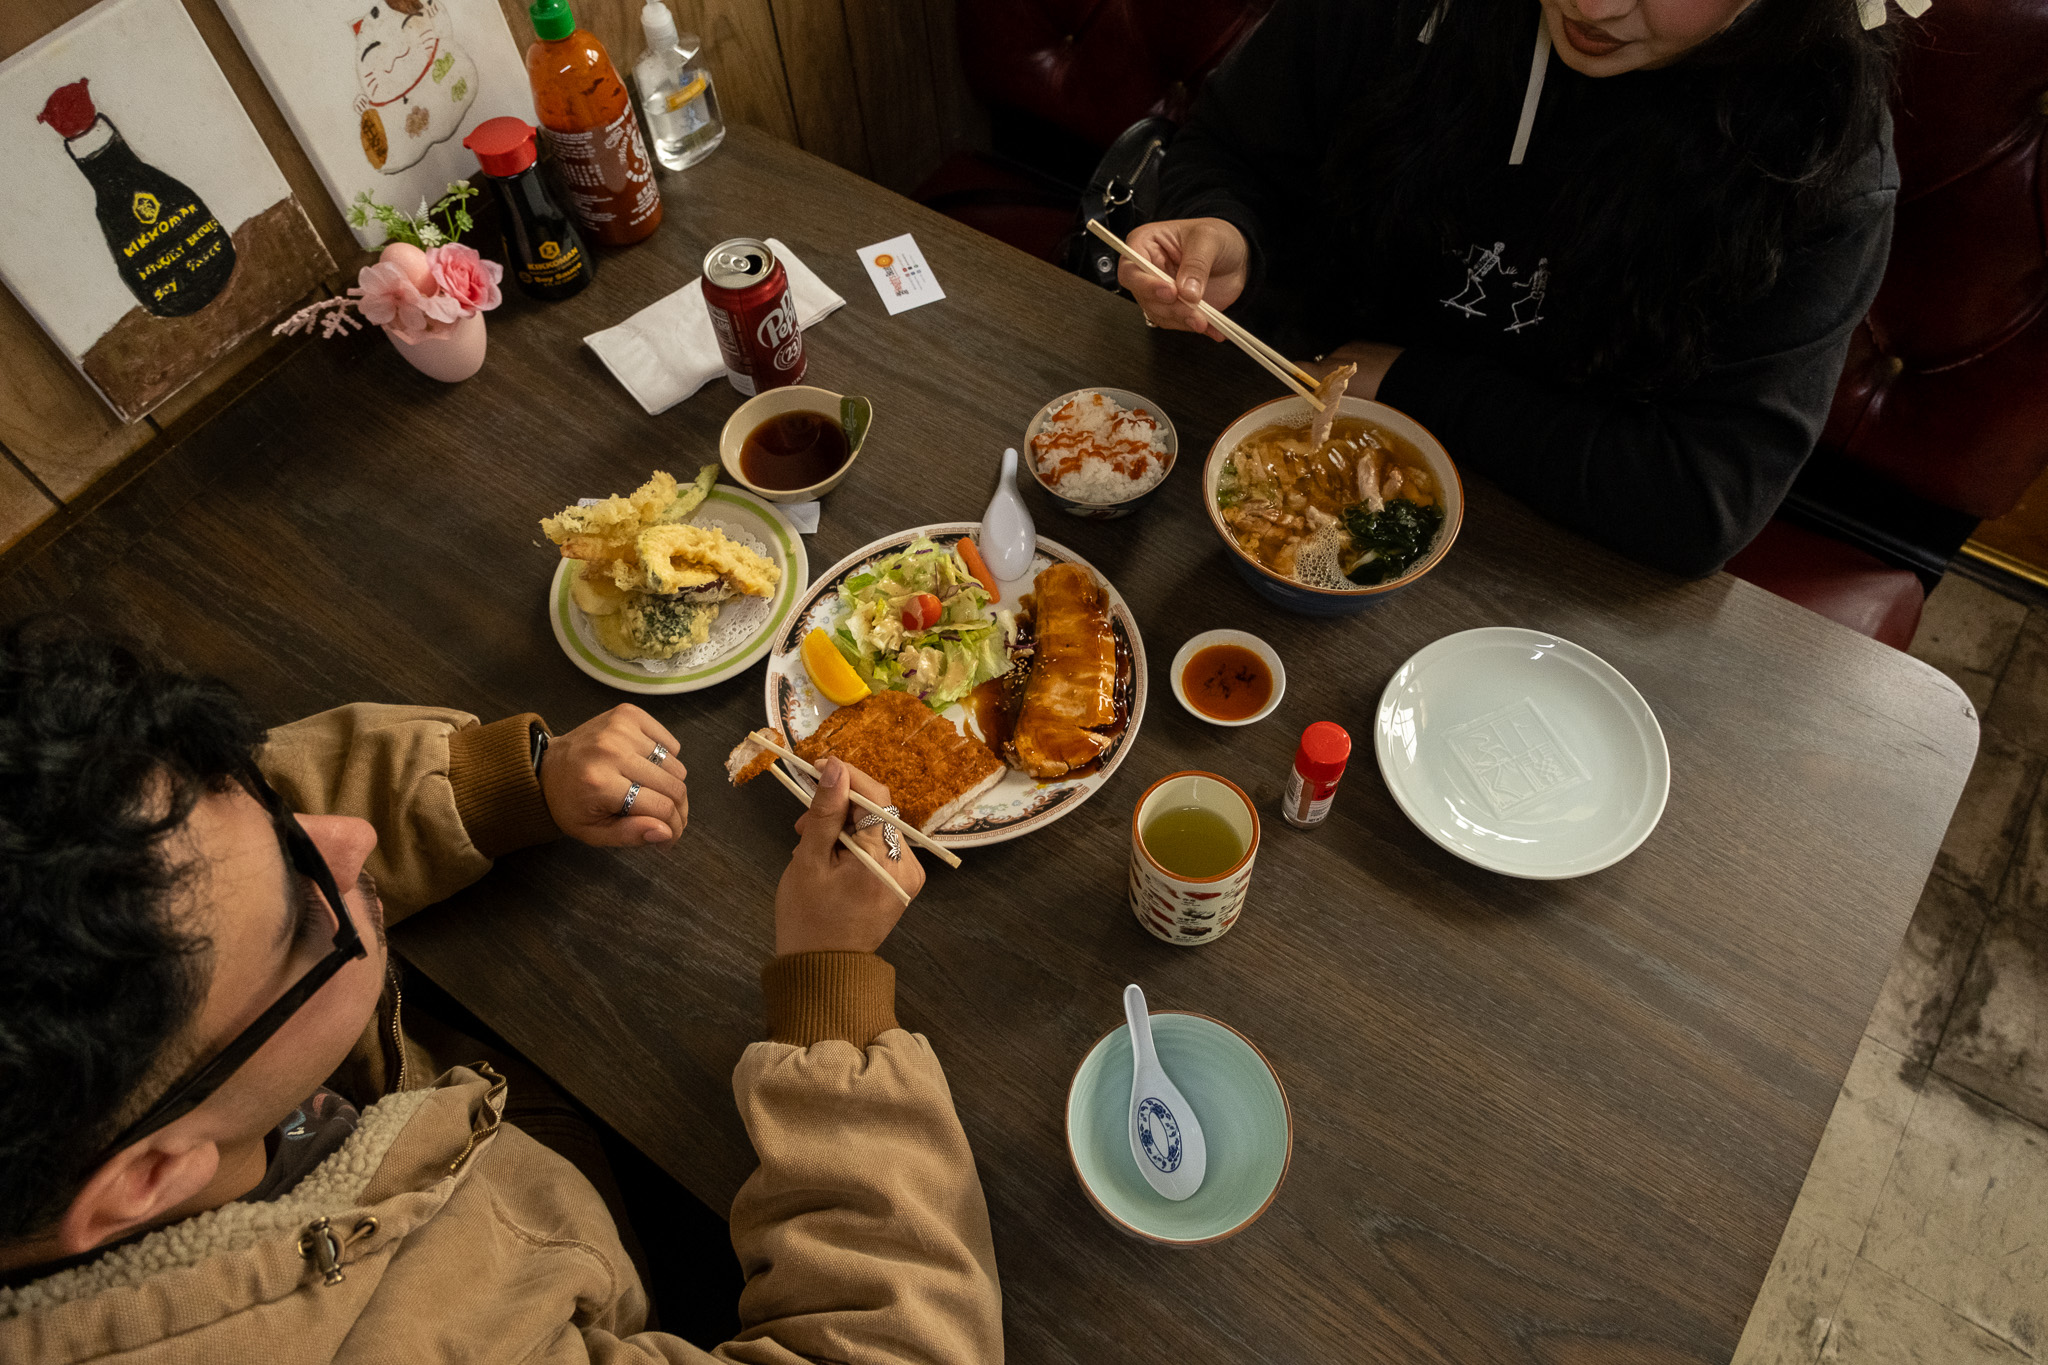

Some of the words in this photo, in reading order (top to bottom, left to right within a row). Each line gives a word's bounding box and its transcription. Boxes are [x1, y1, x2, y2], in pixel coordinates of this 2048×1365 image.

[123, 203, 199, 258] KIKKOMAN
[527, 246, 579, 271] KIKKOMAN
[785, 341, 799, 362] 23
